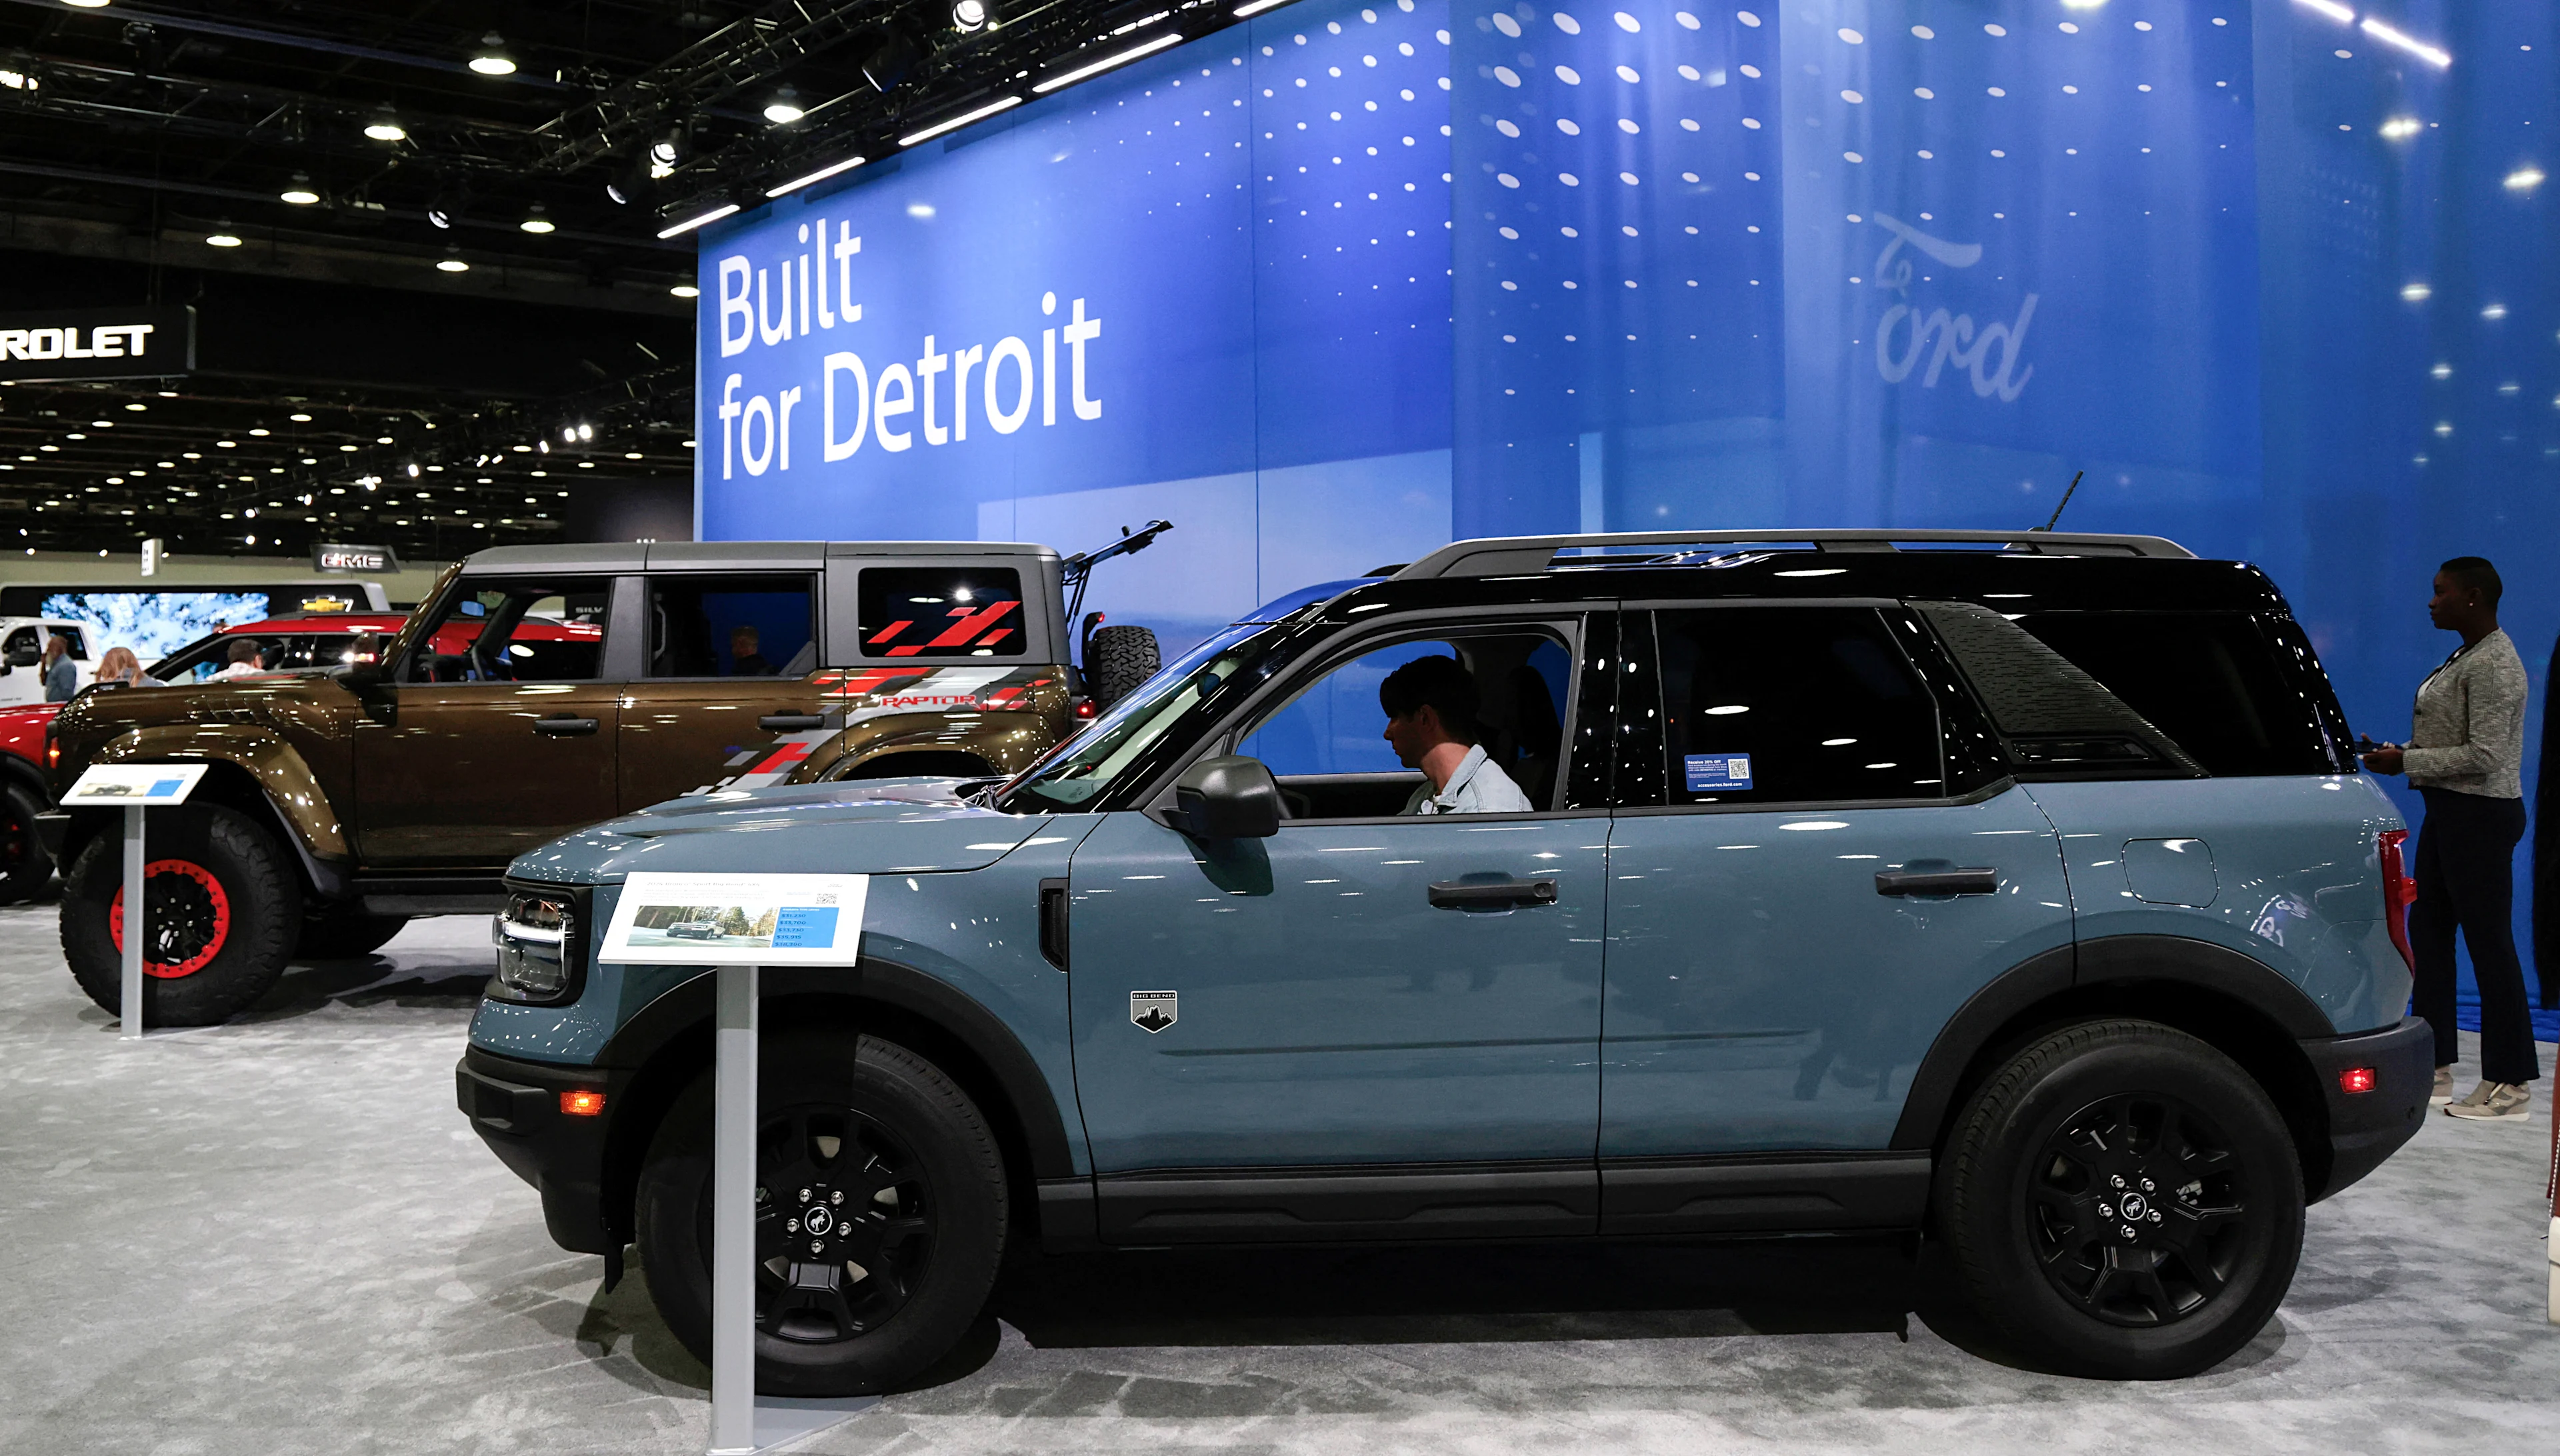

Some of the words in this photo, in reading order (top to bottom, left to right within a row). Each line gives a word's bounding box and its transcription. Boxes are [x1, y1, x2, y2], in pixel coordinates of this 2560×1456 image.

[719, 218, 862, 358] Built
[1873, 211, 2039, 402] Ford
[719, 373, 801, 480] for
[823, 291, 1101, 462] Detroit
[881, 695, 981, 711] RAPTOR
